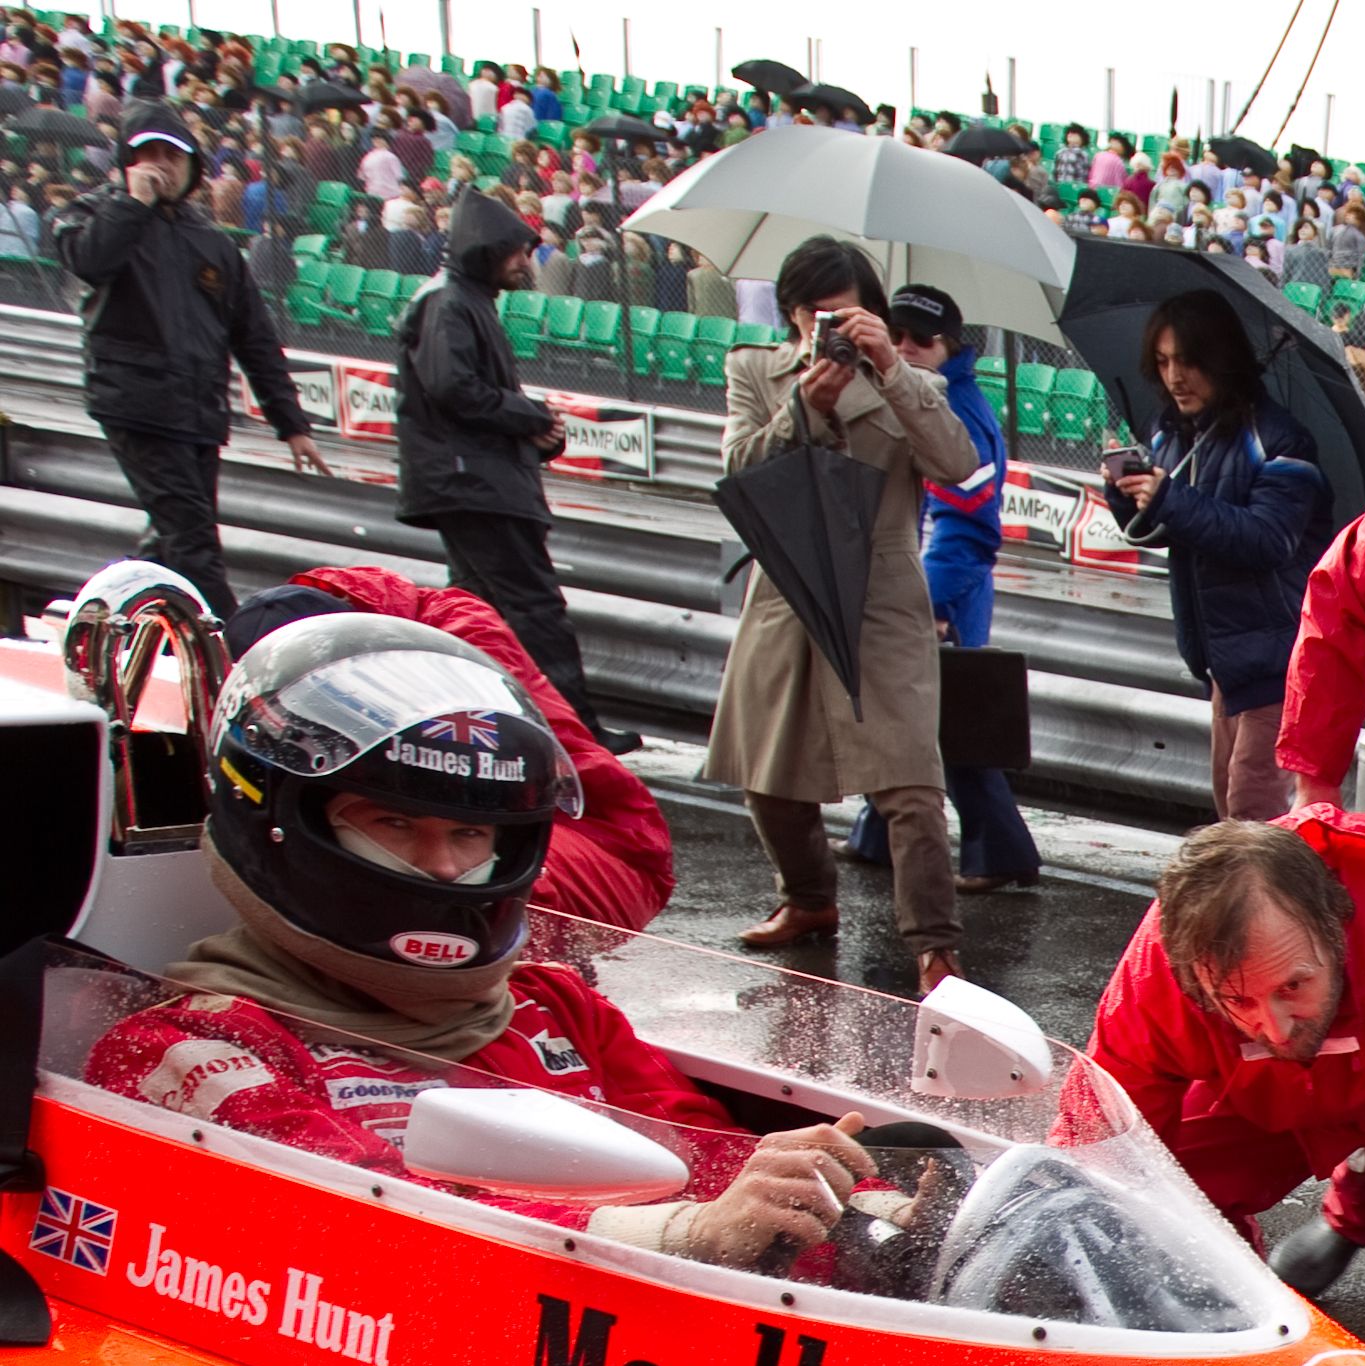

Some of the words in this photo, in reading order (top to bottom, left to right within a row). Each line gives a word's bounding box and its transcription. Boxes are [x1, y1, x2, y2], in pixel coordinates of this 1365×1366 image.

[386, 734, 472, 778] James
[477, 753, 527, 783] Hunt
[404, 938, 469, 959] BELL
[126, 1222, 272, 1327] James
